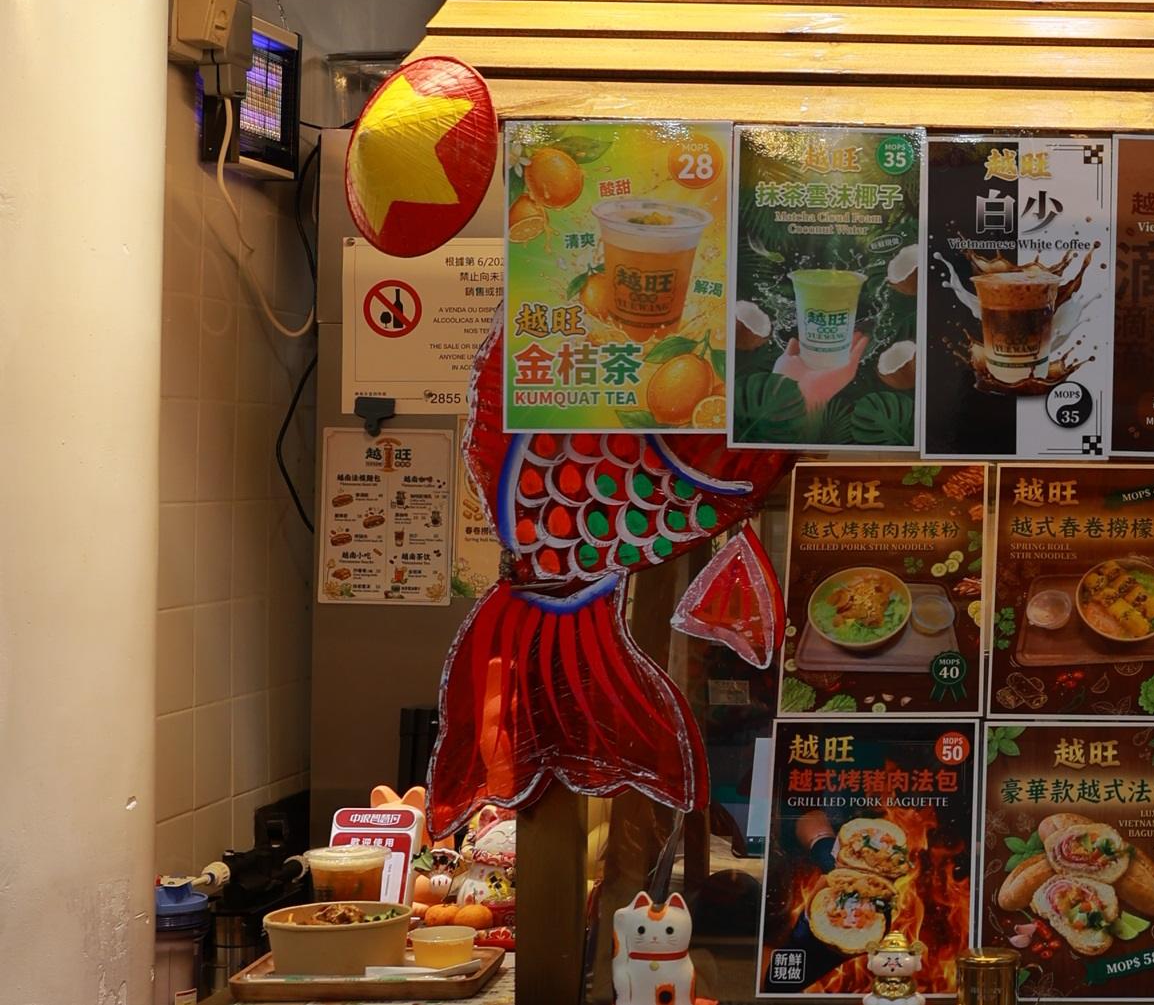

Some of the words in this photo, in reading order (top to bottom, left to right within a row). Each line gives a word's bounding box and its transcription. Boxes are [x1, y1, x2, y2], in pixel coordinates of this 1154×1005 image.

[677, 153, 714, 180] 28
[800, 145, 862, 174] 越旺
[883, 151, 907, 168] 35
[984, 147, 1053, 181] 越旺
[599, 179, 632, 197] 酸甜
[756, 181, 904, 210] 抹茶雲沫椰子
[775, 210, 815, 224] Matcha
[816, 210, 850, 224] Cloud
[852, 210, 882, 224] Foam
[975, 189, 1064, 235] 白少
[788, 223, 834, 236] Coconut
[835, 223, 868, 236] Water
[565, 232, 596, 249] 清爽
[947, 237, 1016, 250] Vietnamese
[1018, 238, 1052, 251] White
[1054, 238, 1091, 251] Coffee
[516, 302, 587, 337] 越旺
[514, 343, 643, 387] 金桔茶
[431, 393, 461, 404] 2855
[515, 392, 600, 406] KUMQUAT
[604, 392, 637, 406] TEA
[1053, 390, 1081, 400] MOP$
[1061, 410, 1080, 425] 35
[802, 477, 886, 514] 越旺
[1012, 478, 1080, 508] 越旺
[801, 521, 961, 540] 越式烤豬肉撈檬粉
[800, 543, 839, 552] GRILLED
[840, 543, 866, 552] PORK
[867, 543, 889, 553] STIR
[891, 543, 934, 553] NOODLES
[1010, 542, 1045, 552] SPRING
[1047, 542, 1072, 552] ROLL
[1010, 551, 1031, 561] STIR
[1033, 551, 1077, 561] NOODLES
[938, 666, 960, 680] 40
[787, 734, 855, 764] 越旺
[941, 745, 964, 761] 50
[1053, 739, 1121, 769] 越旺
[788, 769, 959, 793] 越式烤豬肉法包
[787, 797, 846, 807] GRILLLED
[850, 797, 883, 807] PORK
[886, 797, 949, 807] BAGUETTE
[774, 953, 803, 967] 新鮮
[1106, 956, 1141, 975] MOP$
[774, 966, 803, 981] 現做
